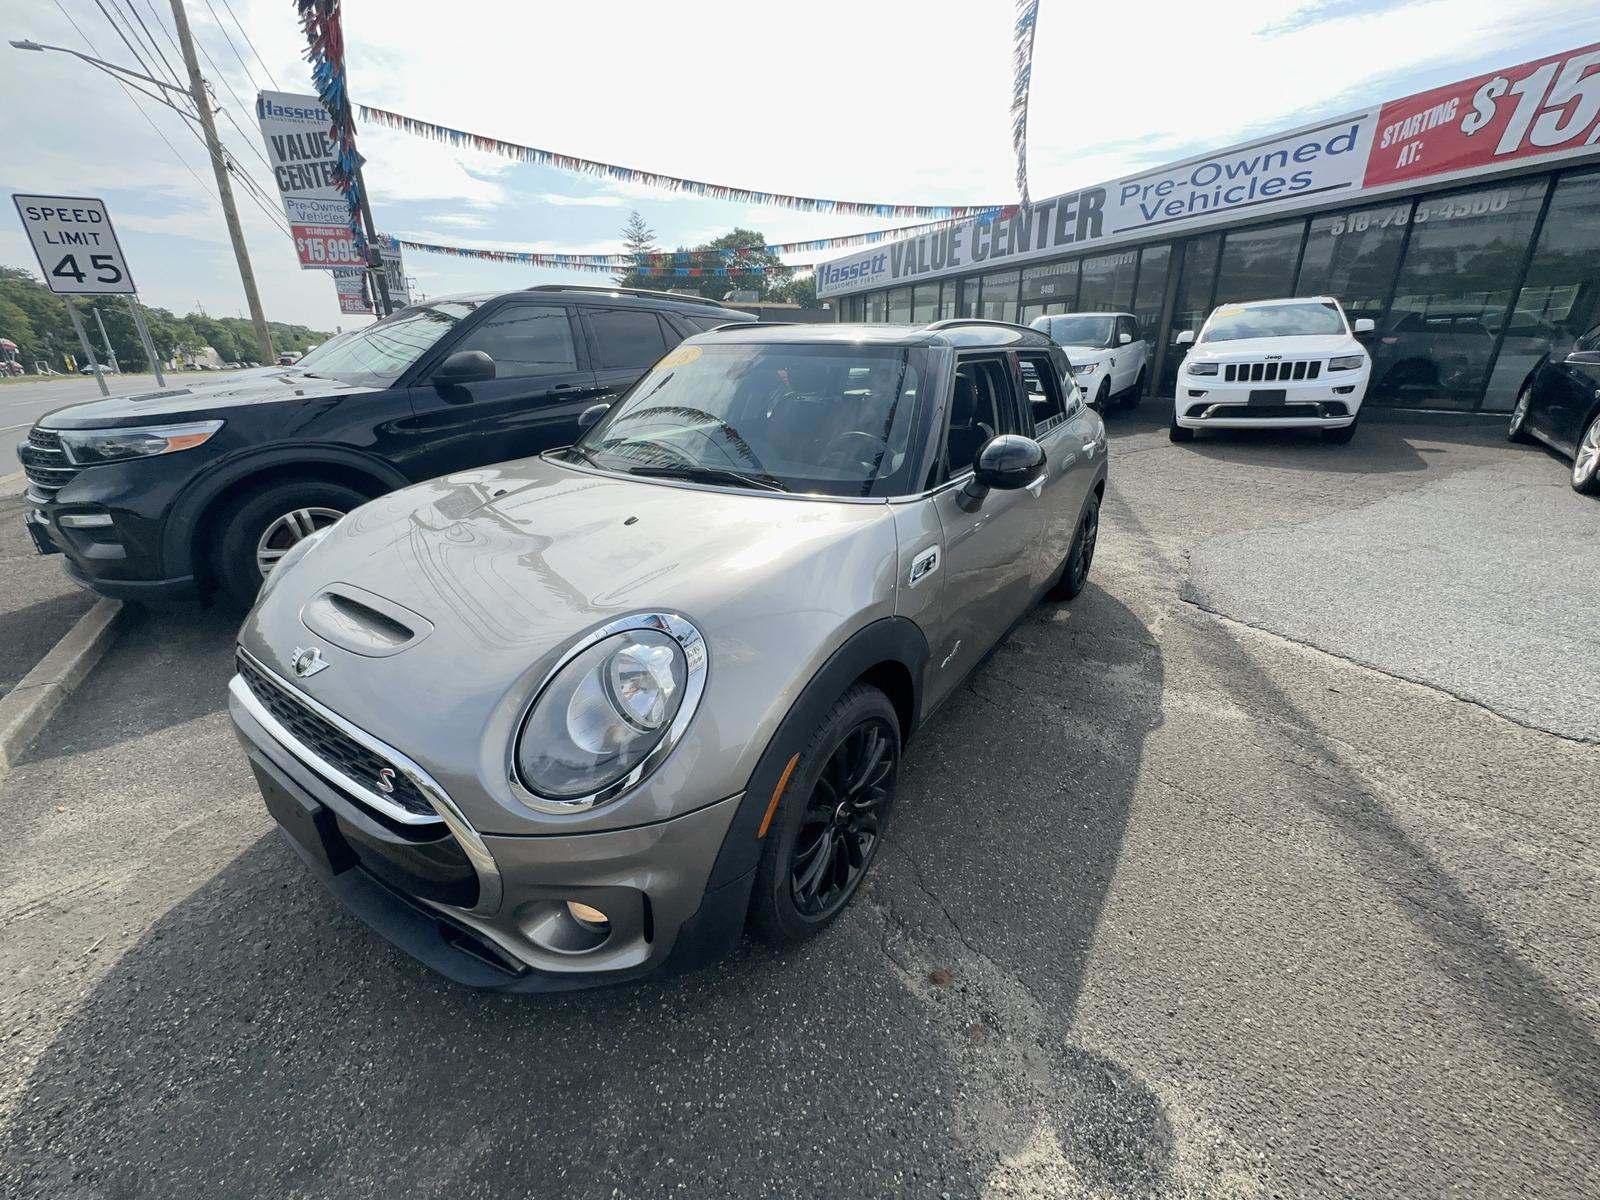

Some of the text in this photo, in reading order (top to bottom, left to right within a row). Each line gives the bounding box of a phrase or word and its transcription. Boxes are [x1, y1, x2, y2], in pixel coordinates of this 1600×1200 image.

[257, 97, 329, 122] Hassett
[1380, 97, 1460, 150] STARTING
[271, 131, 333, 162] VALUE
[1396, 141, 1424, 169] AT:
[1120, 124, 1360, 206] Pre-Owned
[1139, 169, 1312, 222] Vehicles
[26, 206, 102, 223] SPEED
[297, 211, 346, 221] Vehicles
[43, 230, 100, 246] LIMIT
[890, 187, 1107, 279] VALUE CENTER
[52, 254, 122, 284] 45
[818, 253, 887, 293] Hassett
